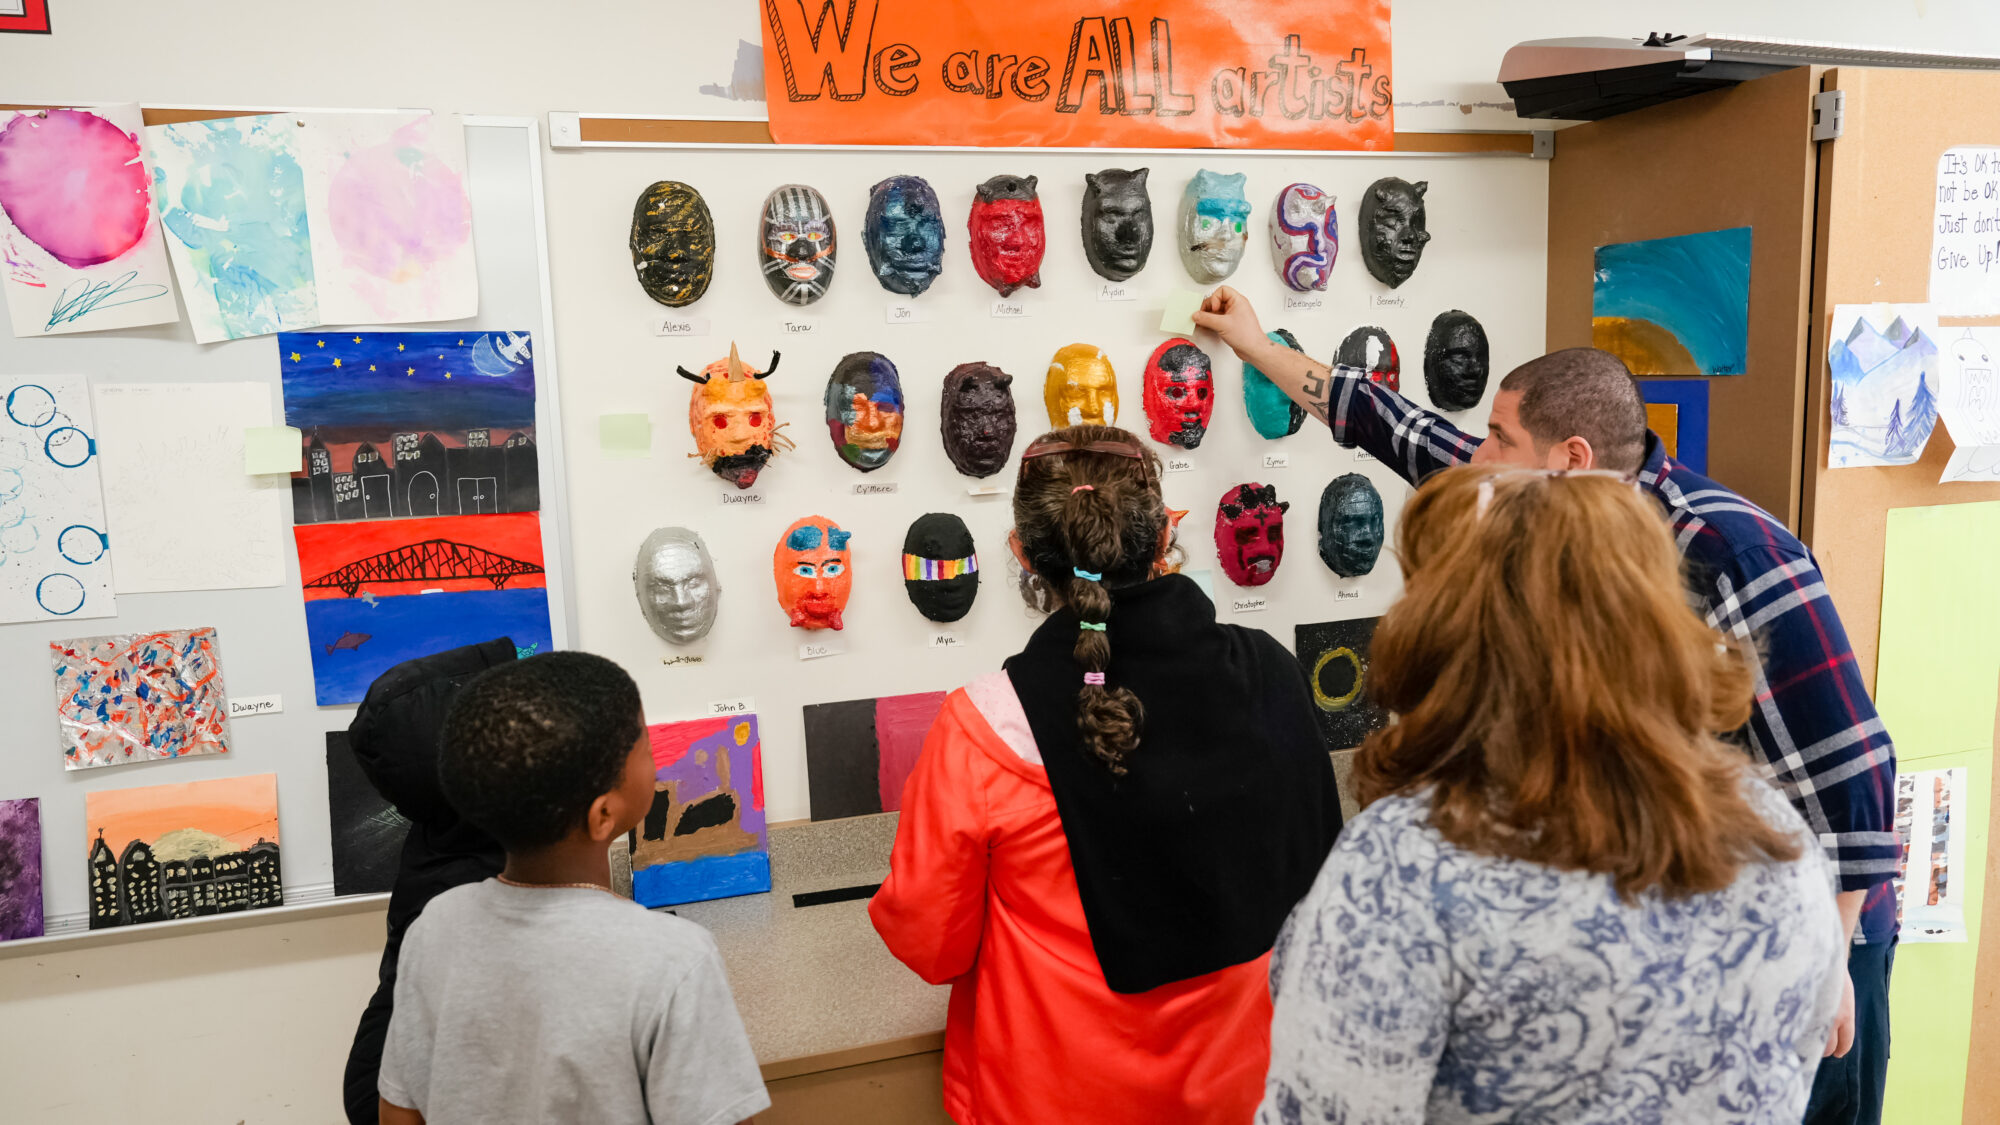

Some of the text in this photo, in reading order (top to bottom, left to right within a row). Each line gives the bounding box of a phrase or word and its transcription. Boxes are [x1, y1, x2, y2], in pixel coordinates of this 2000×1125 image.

[765, 0, 1391, 122] We are ALL artists
[1944, 153, 1968, 175] It's
[1974, 153, 1987, 174] OK
[1939, 180, 1998, 203] not be OK
[1939, 212, 1968, 234] Just
[1937, 240, 2000, 273] Give Up!
[1101, 285, 1125, 298] Aydin
[1376, 295, 1406, 307] Serenity
[894, 307, 911, 319] Jon
[995, 303, 1023, 314] Michael
[662, 320, 692, 332] Alexis
[785, 322, 812, 332] Tara
[1169, 461, 1190, 470] Gabe
[1266, 456, 1285, 467] Zymir
[723, 492, 762, 504] Dwayne
[1337, 590, 1359, 599] Ahmad
[1233, 600, 1265, 610] Christopher
[935, 636, 956, 645] Mya
[806, 646, 828, 656] Blue
[231, 699, 274, 714] Dwayne
[713, 703, 736, 712] John
